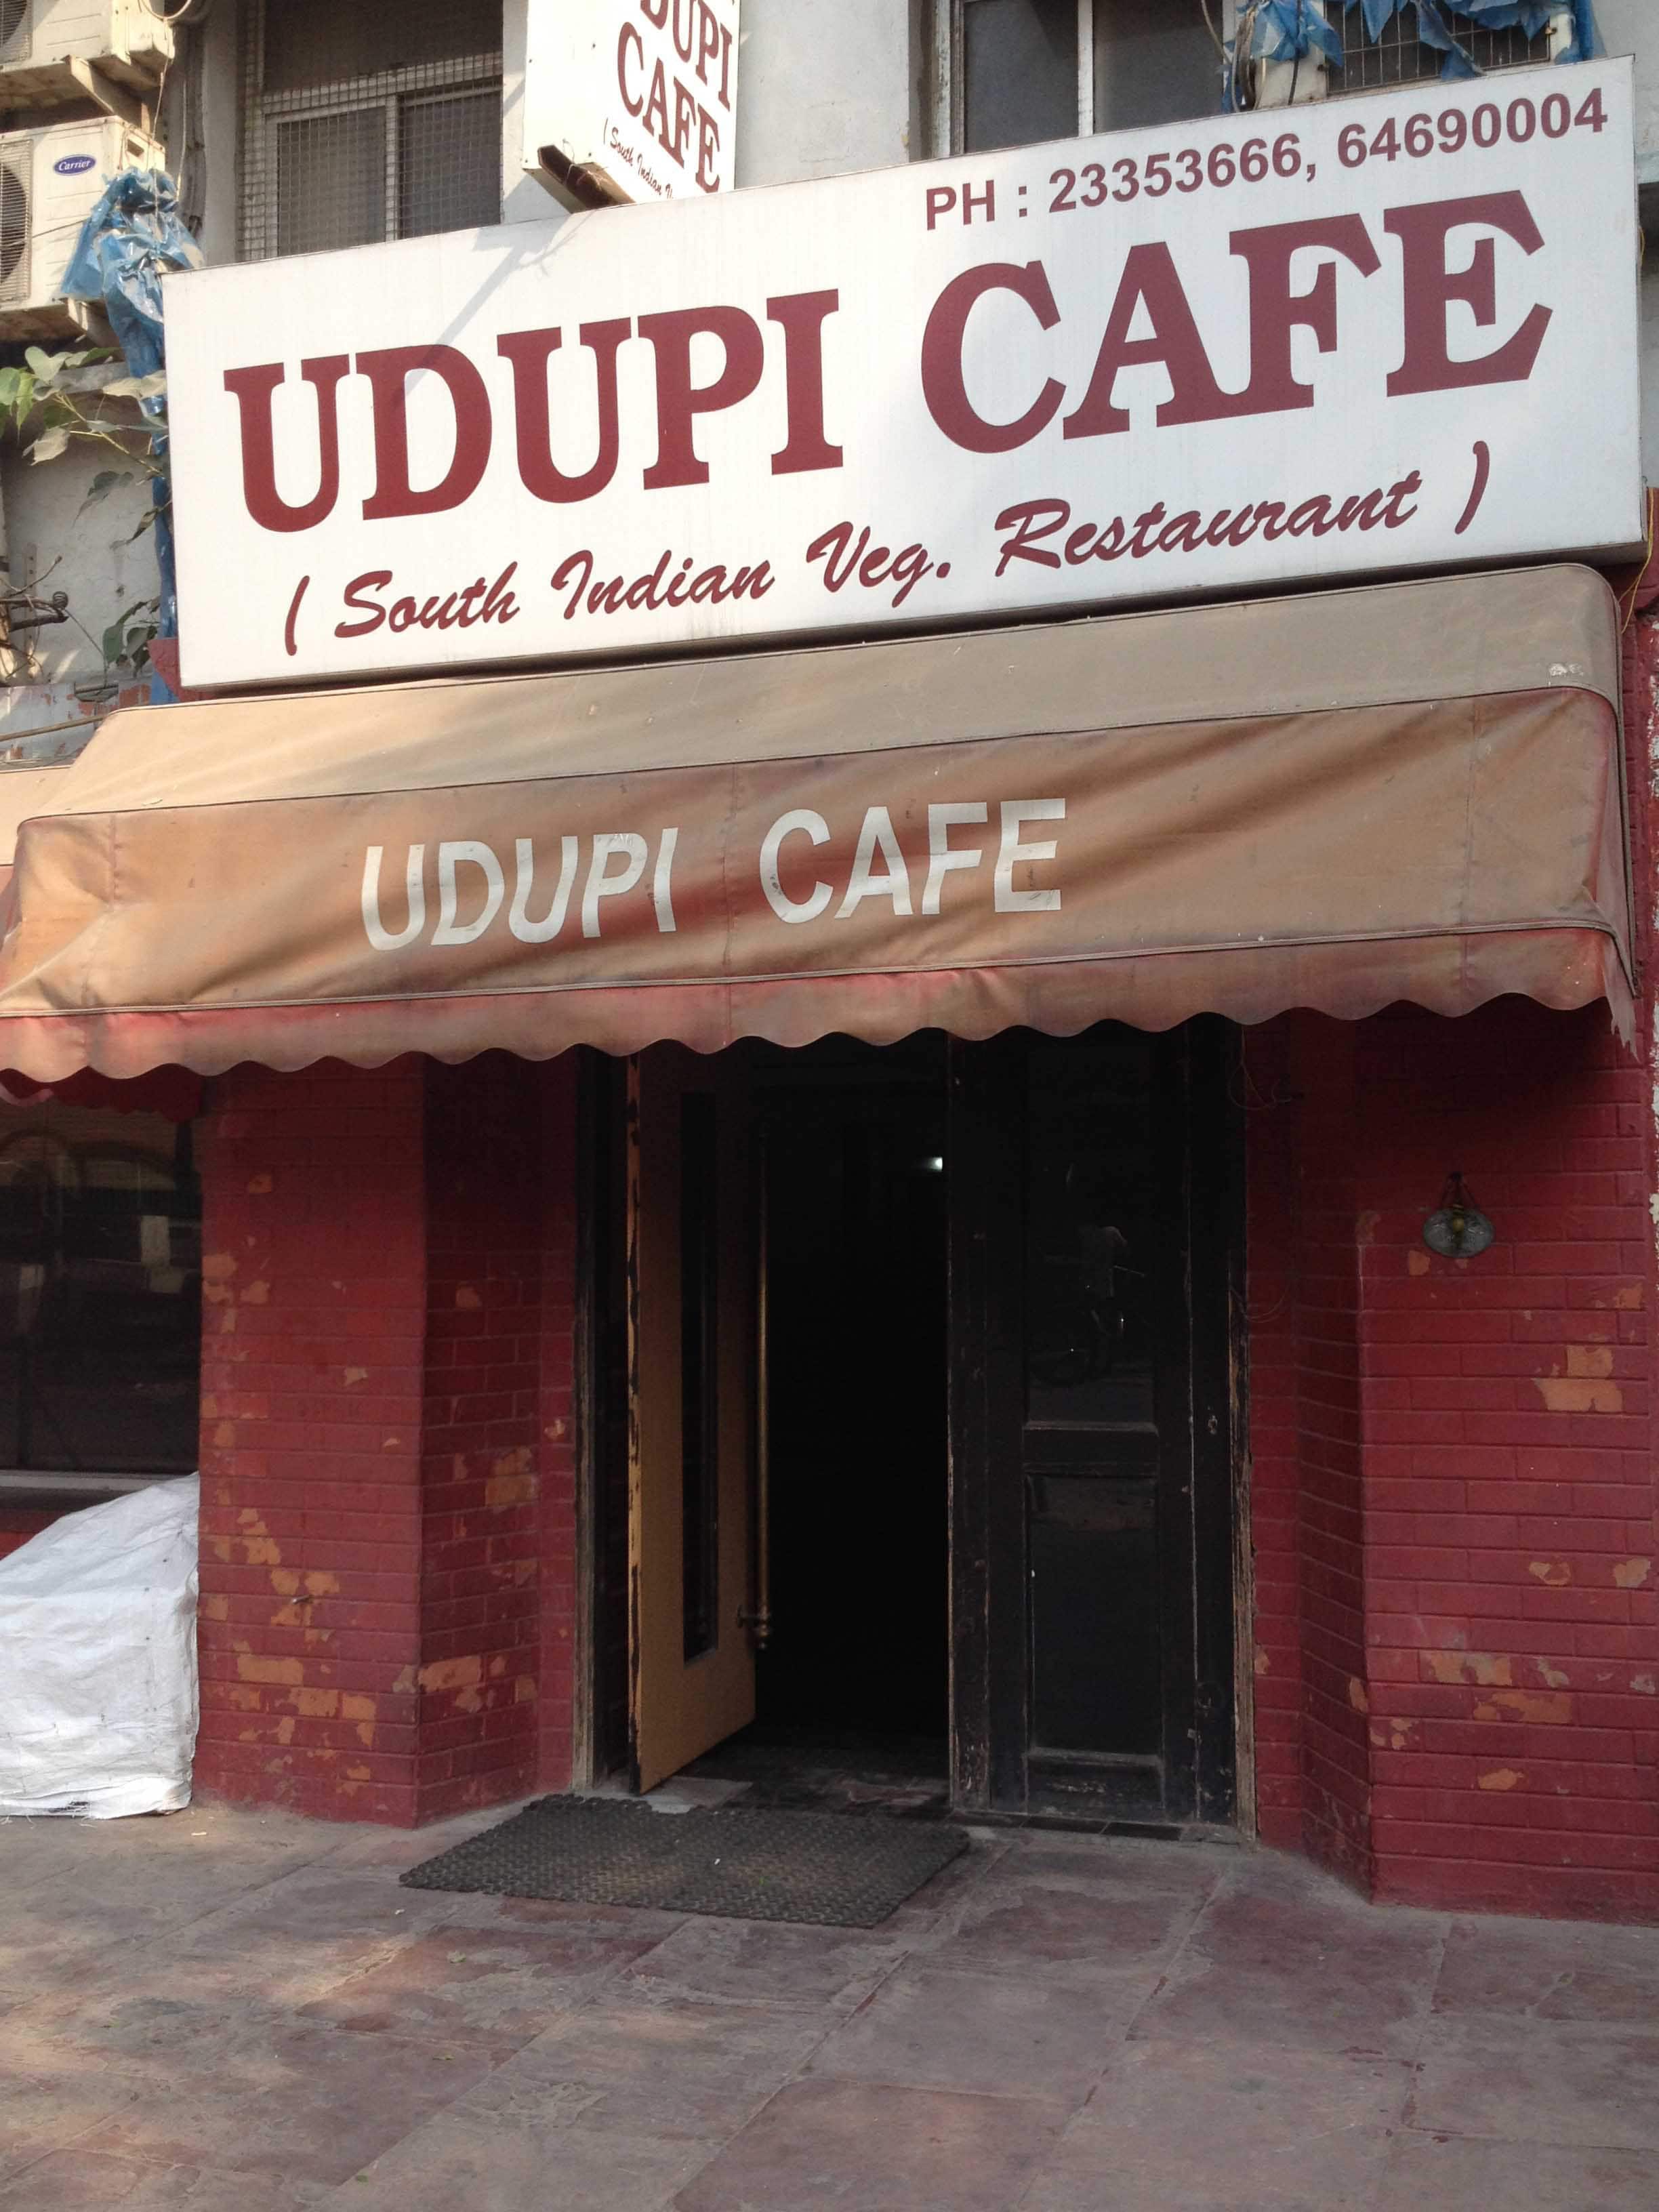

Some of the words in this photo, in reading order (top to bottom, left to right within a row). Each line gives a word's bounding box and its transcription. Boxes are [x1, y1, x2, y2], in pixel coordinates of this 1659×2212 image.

[58, 160, 91, 171] Carrier
[617, 22, 720, 194] CAFE
[926, 180, 995, 230] PH
[1050, 134, 1317, 212] 23353666,
[1337, 88, 1608, 167] 64690004
[223, 288, 844, 533] UDUPI
[921, 190, 1552, 454] CAFE
[335, 562, 520, 638] South
[550, 550, 775, 619] Indian
[806, 520, 951, 608] Veg.
[994, 470, 1422, 577] Restaurant
[361, 827, 678, 950] UDUPI
[759, 798, 1066, 924] CAFE
